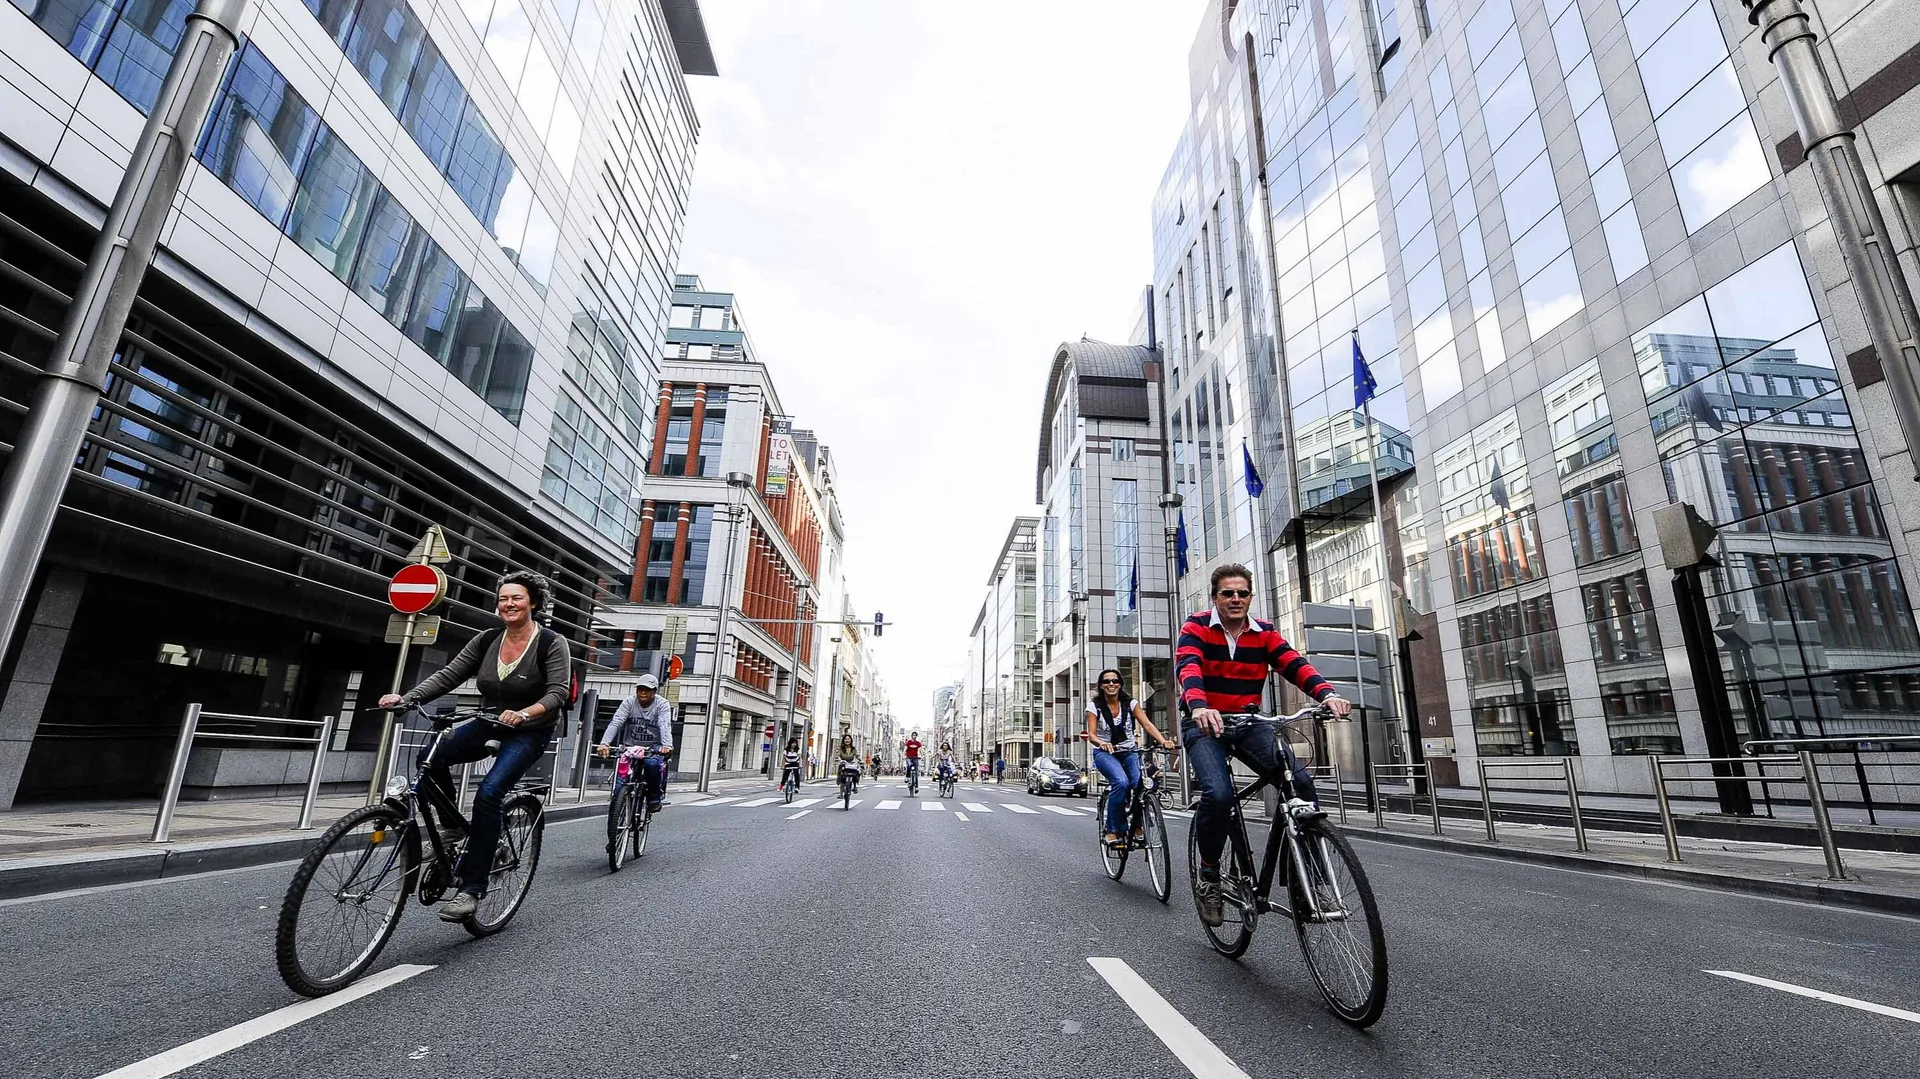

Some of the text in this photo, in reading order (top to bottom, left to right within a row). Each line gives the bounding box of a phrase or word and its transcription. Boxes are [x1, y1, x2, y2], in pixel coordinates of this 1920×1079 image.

[772, 438, 788, 449] TO
[770, 450, 789, 460] LET
[1428, 715, 1437, 727] 41
